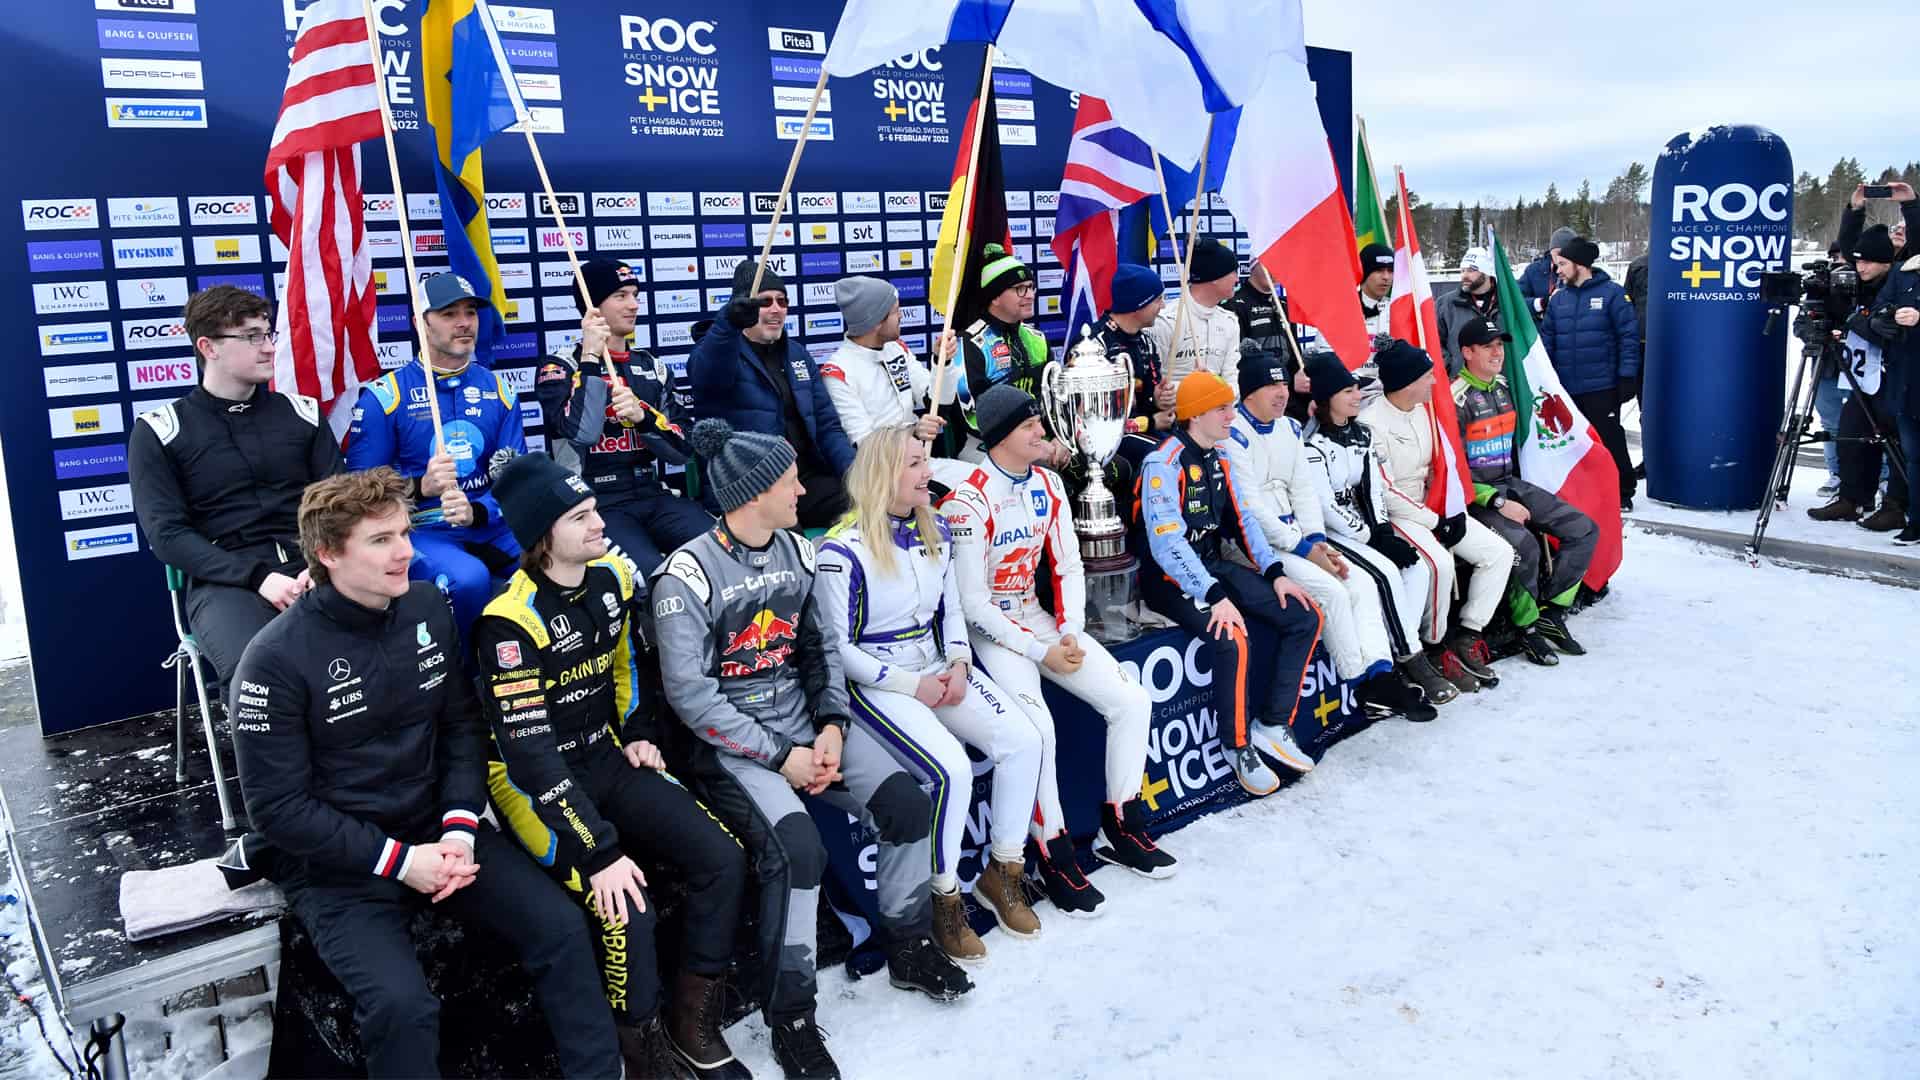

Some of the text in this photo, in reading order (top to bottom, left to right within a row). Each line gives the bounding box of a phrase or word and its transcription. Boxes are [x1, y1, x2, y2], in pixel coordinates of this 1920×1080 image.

[105, 30, 193, 41] BANG & OLUFSEN
[620, 15, 717, 55] ROC
[784, 34, 812, 49] Piteå
[624, 53, 646, 61] RACE
[666, 55, 719, 65] CHAMPIONS
[109, 70, 197, 79] PORSCHE
[624, 62, 718, 90] SNOW
[873, 78, 944, 101] SNOW
[138, 109, 195, 118] MICHELIN
[690, 119, 723, 127] SWEDEN
[632, 126, 638, 134] 5
[652, 126, 700, 136] FEBRUARY
[702, 128, 724, 136] 2022
[894, 134, 932, 142] FEBRUARY
[596, 198, 626, 208] ROC
[704, 198, 730, 207] ROC
[801, 198, 825, 206] ROC
[888, 196, 909, 205] ROC
[1672, 182, 1788, 222] ROC
[29, 206, 75, 219] ROC
[194, 202, 235, 214] ROC
[134, 213, 175, 222] HAVSBAD
[607, 228, 632, 240] IWC
[854, 225, 874, 240] svt
[1672, 225, 1698, 233] RACE
[1704, 224, 1721, 232] OF
[1670, 236, 1786, 261] SNOW
[32, 254, 56, 262] BANG
[64, 251, 99, 260] OLUFSEN
[52, 286, 89, 300] IWC
[813, 286, 833, 296] IWC
[1668, 292, 1687, 300] PITE
[41, 302, 104, 310] SCHAFFHAUSEN
[129, 325, 170, 339] ROC
[49, 374, 113, 384] PORSCHE
[465, 407, 482, 418] ally
[90, 456, 124, 465] OLUFSEN
[79, 490, 115, 506] IWC
[67, 504, 130, 516] SCHAFFHAUSEN
[552, 631, 583, 652] HONDA
[418, 652, 445, 672] INEOS
[241, 680, 269, 696] EPSON
[342, 690, 364, 705] UBS
[238, 723, 260, 732] AMD
[1147, 707, 1218, 764] NOW
